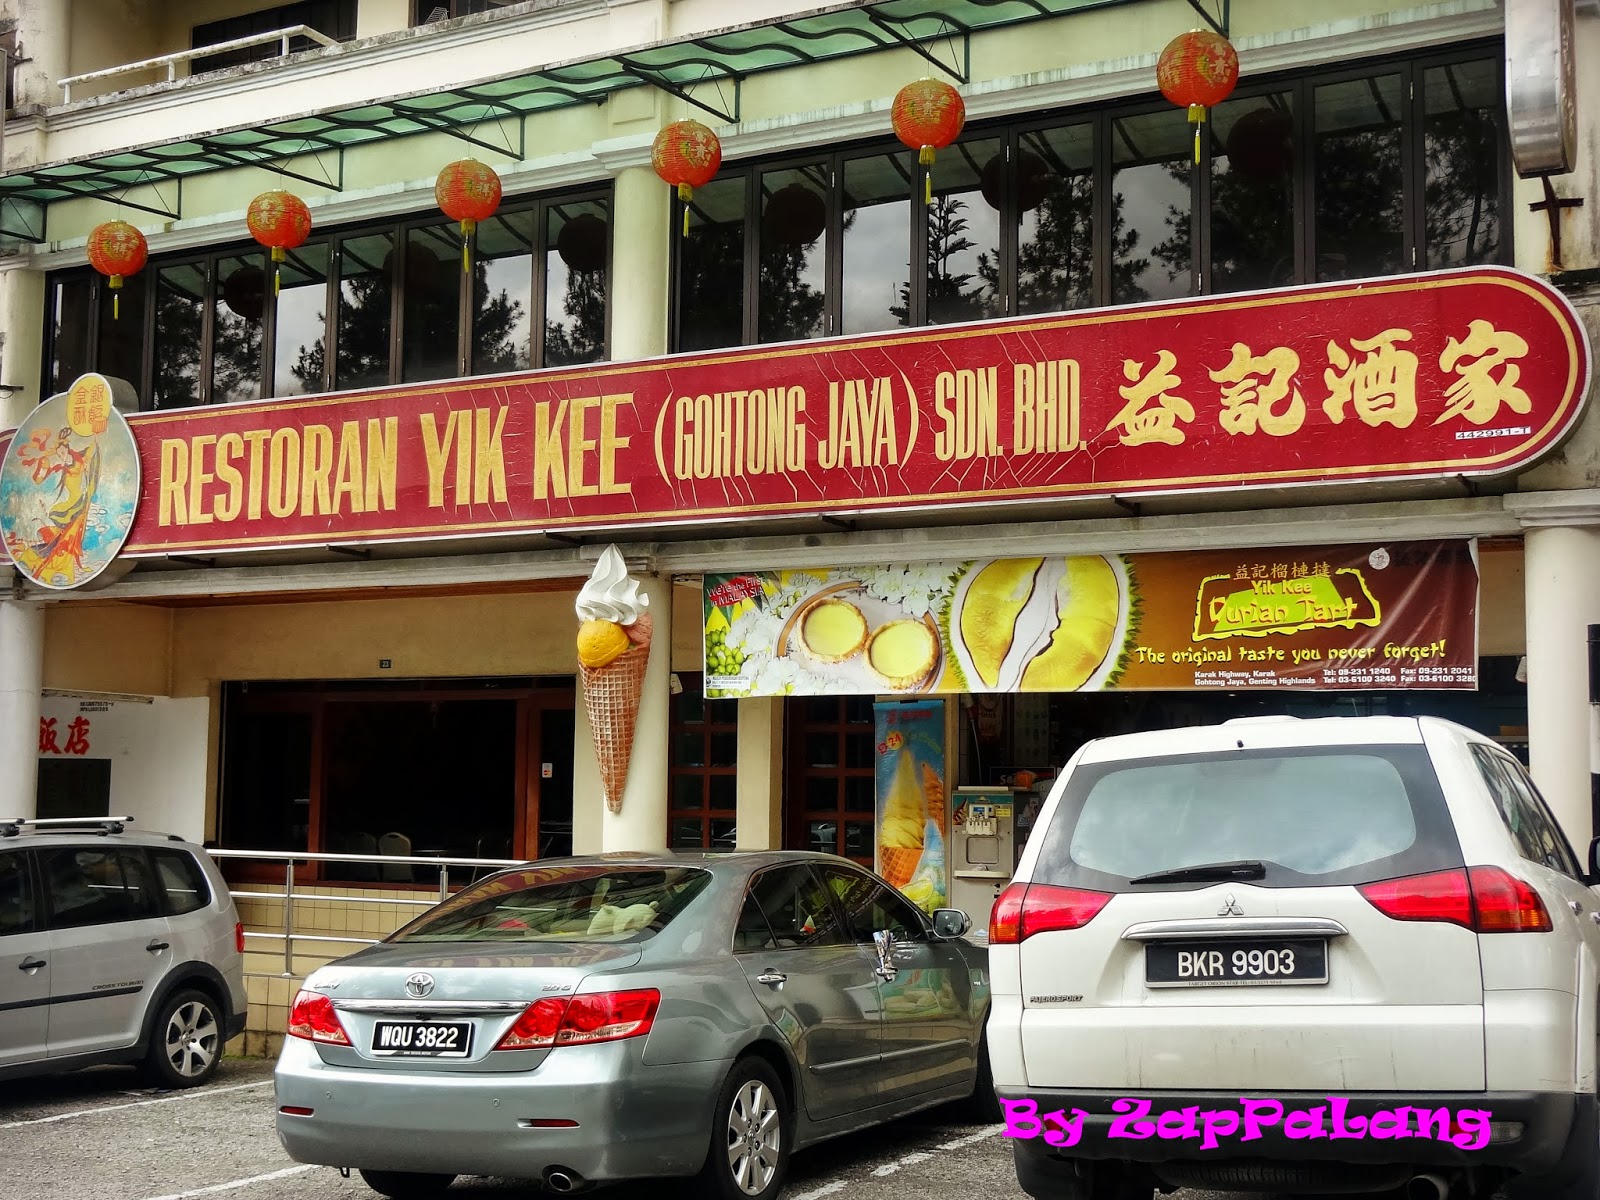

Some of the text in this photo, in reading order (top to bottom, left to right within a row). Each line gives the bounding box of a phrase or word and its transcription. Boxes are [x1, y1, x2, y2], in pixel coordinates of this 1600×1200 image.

[1106, 319, 1532, 447] 益記酒家
[1457, 426, 1529, 439] 442991-T
[158, 359, 1087, 527] RESTORAN YIK KEE (GOHTONG JAYA) SDN. BHD.
[719, 587, 765, 606] MALAYSIA
[1251, 579, 1313, 597] Yik Kee
[1208, 595, 1358, 624] Durian Tart
[1135, 639, 1447, 667] The original taste you never forget!
[1218, 671, 1252, 680] Highway,
[1253, 670, 1276, 678] Karak
[1323, 668, 1337, 676] Tel:
[1374, 675, 1397, 683] 3240
[1400, 667, 1473, 675] Fax: 09-231 2041
[1400, 675, 1417, 683] Fax:
[1194, 677, 1316, 687] Gohtong Jaya, Genting Highlands
[1178, 949, 1296, 977] BKR 9903
[380, 1025, 459, 1048] WQU 3822
